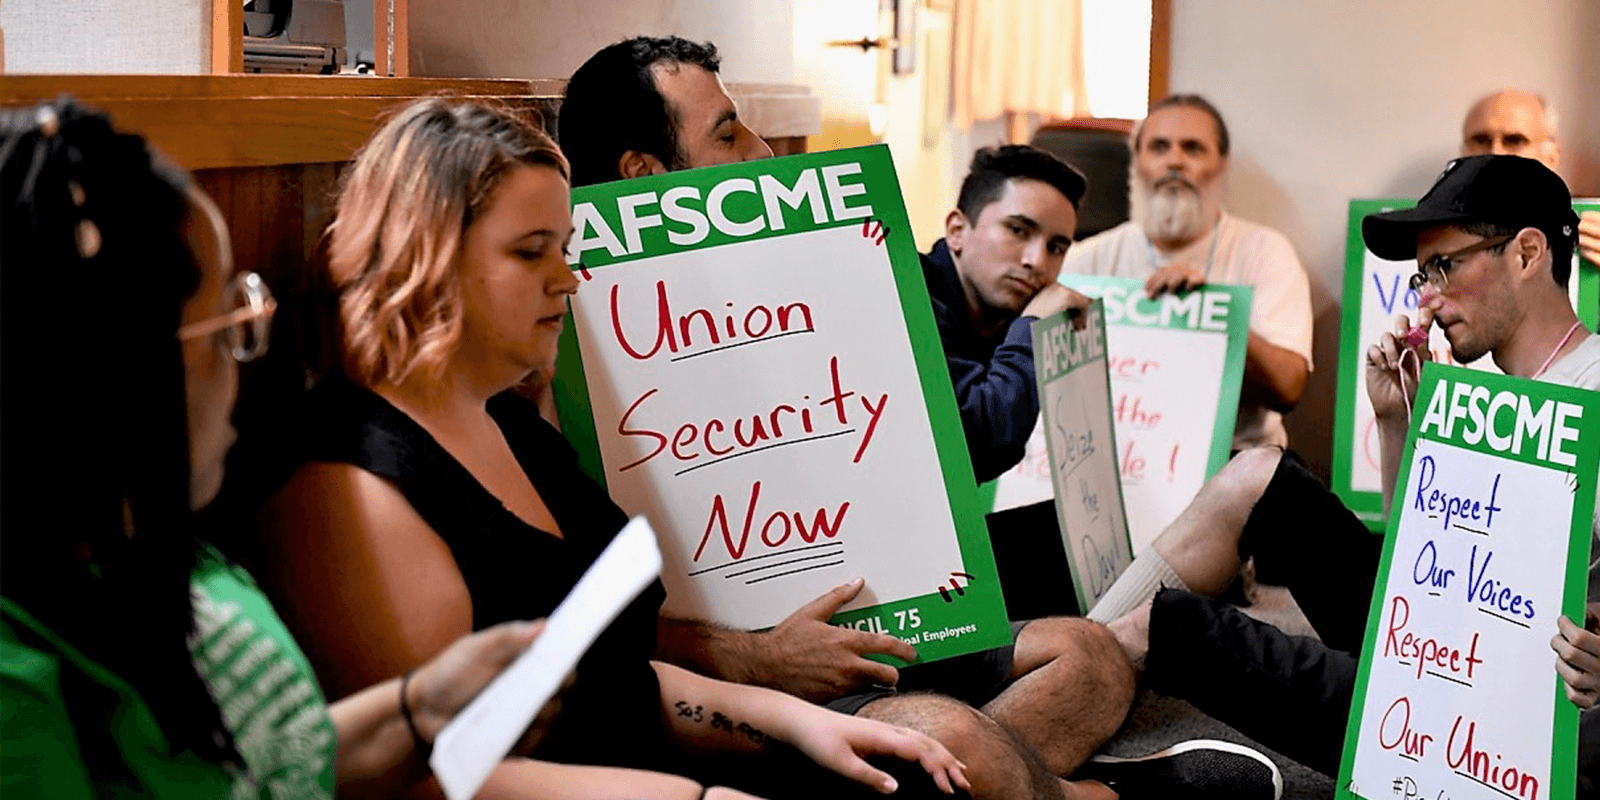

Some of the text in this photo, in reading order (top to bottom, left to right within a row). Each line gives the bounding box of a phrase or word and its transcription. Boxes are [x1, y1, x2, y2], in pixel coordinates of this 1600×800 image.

[565, 162, 874, 265] AFSCME
[609, 280, 815, 360] Union
[1079, 283, 1232, 331] SCME
[618, 356, 889, 472] Security
[1419, 378, 1584, 468] AFSCME
[692, 480, 851, 562] Now
[1414, 455, 1502, 531] Respect
[893, 608, 922, 631] 75
[1413, 540, 1536, 620] Our Voices
[923, 623, 977, 643] Employees
[1383, 595, 1484, 680] Respect
[1379, 696, 1540, 800] Our Union
